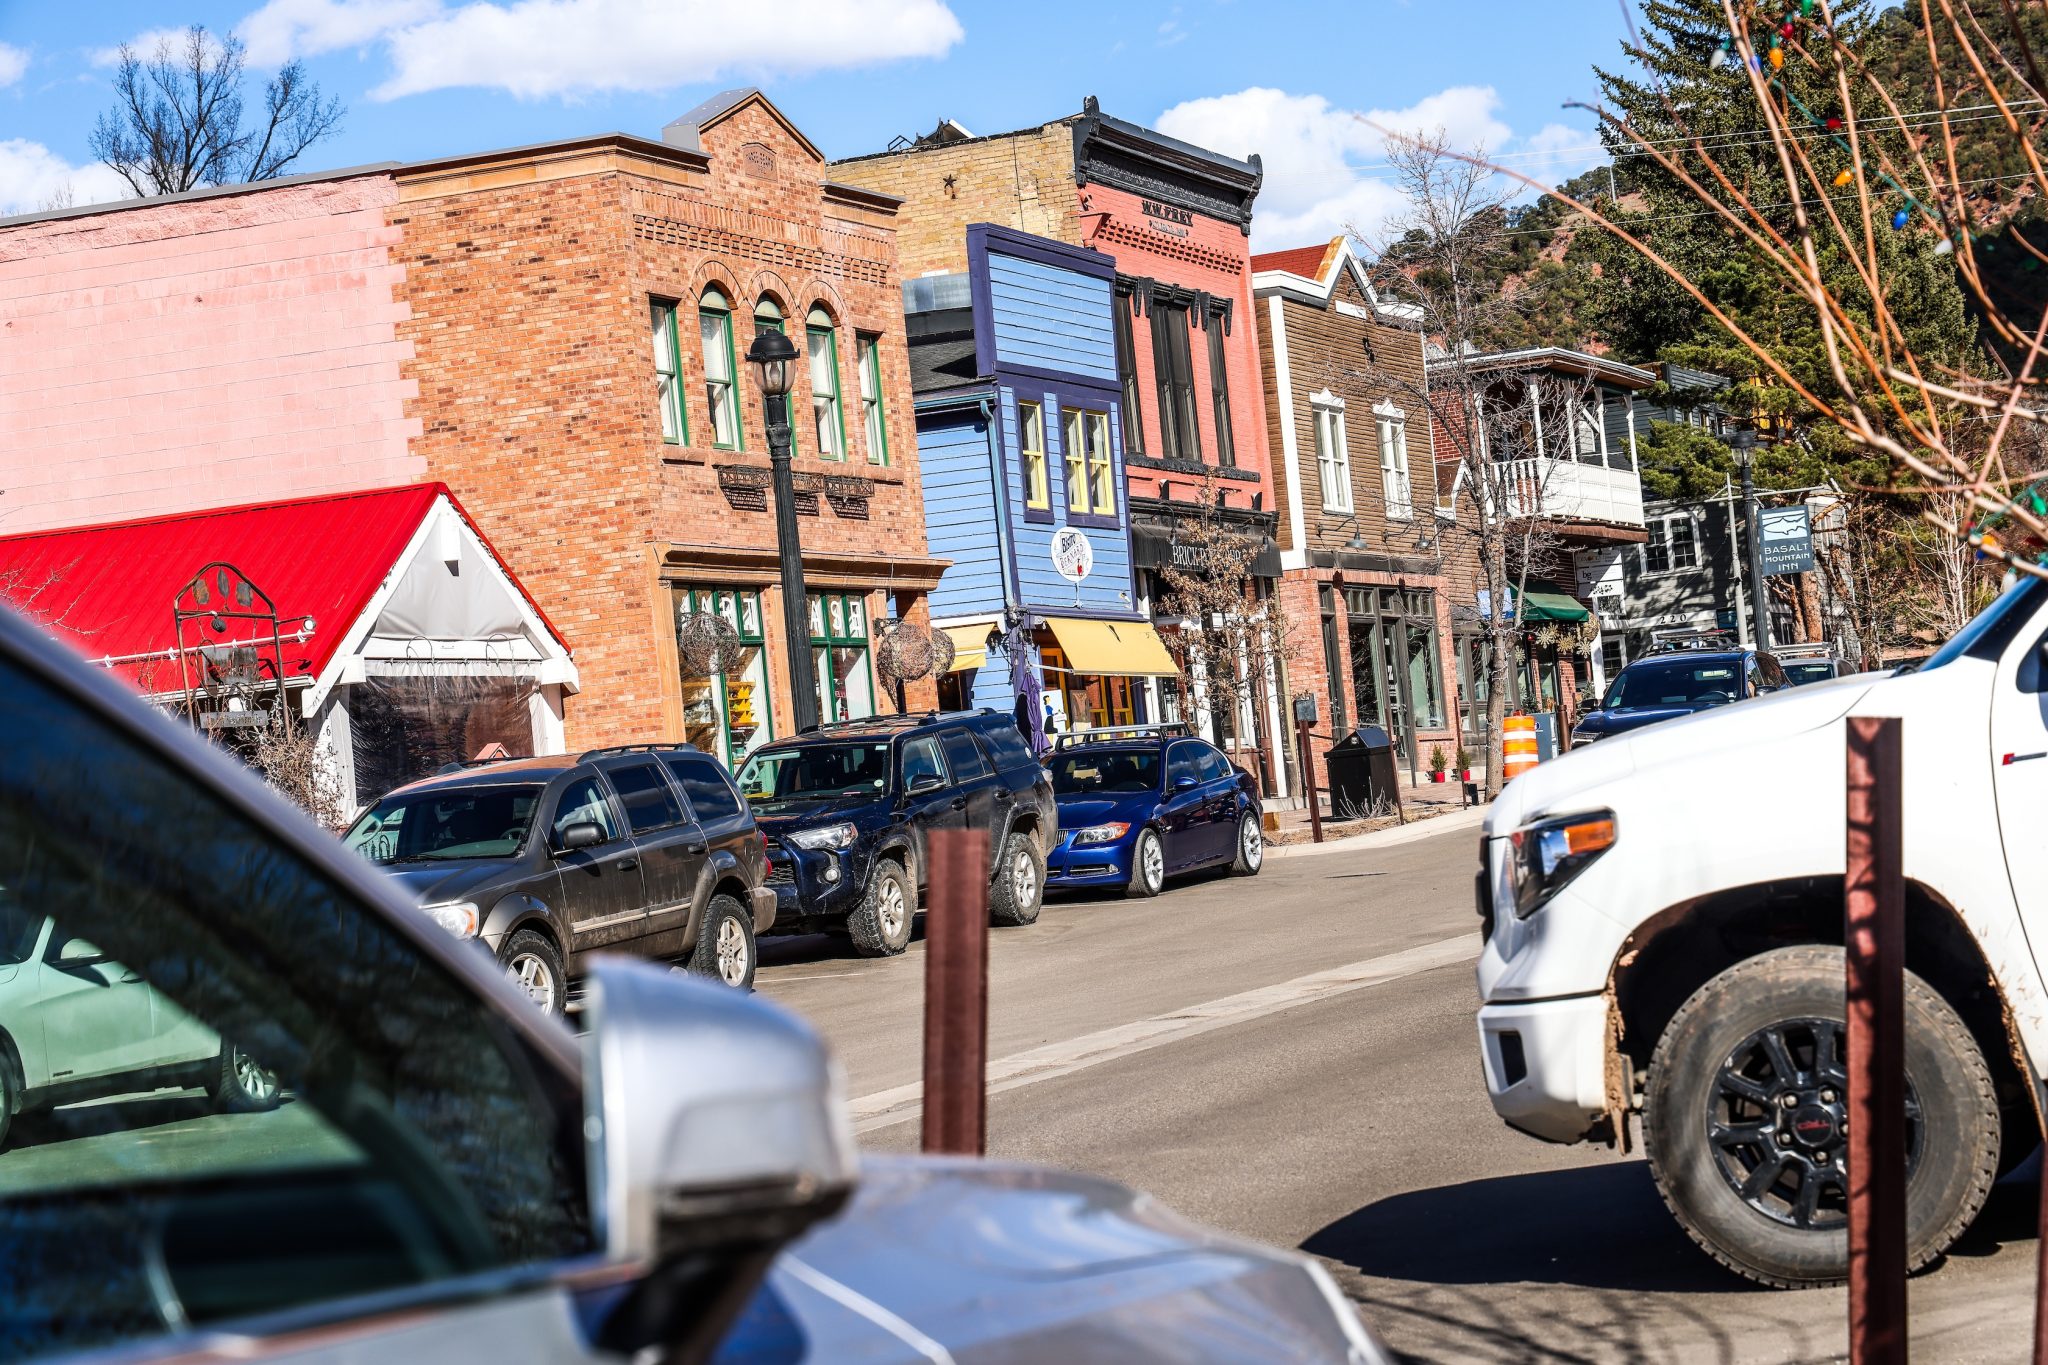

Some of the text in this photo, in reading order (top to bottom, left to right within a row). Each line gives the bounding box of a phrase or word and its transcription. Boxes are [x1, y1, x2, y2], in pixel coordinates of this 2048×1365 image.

[1164, 206, 1193, 226] FREY
[1764, 543, 1808, 555] BASALT
[1172, 545, 1199, 566] BRICK
[1765, 553, 1810, 563] MOUNTAIN
[1778, 562, 1799, 571] INN
[1660, 613, 1687, 624] 220
